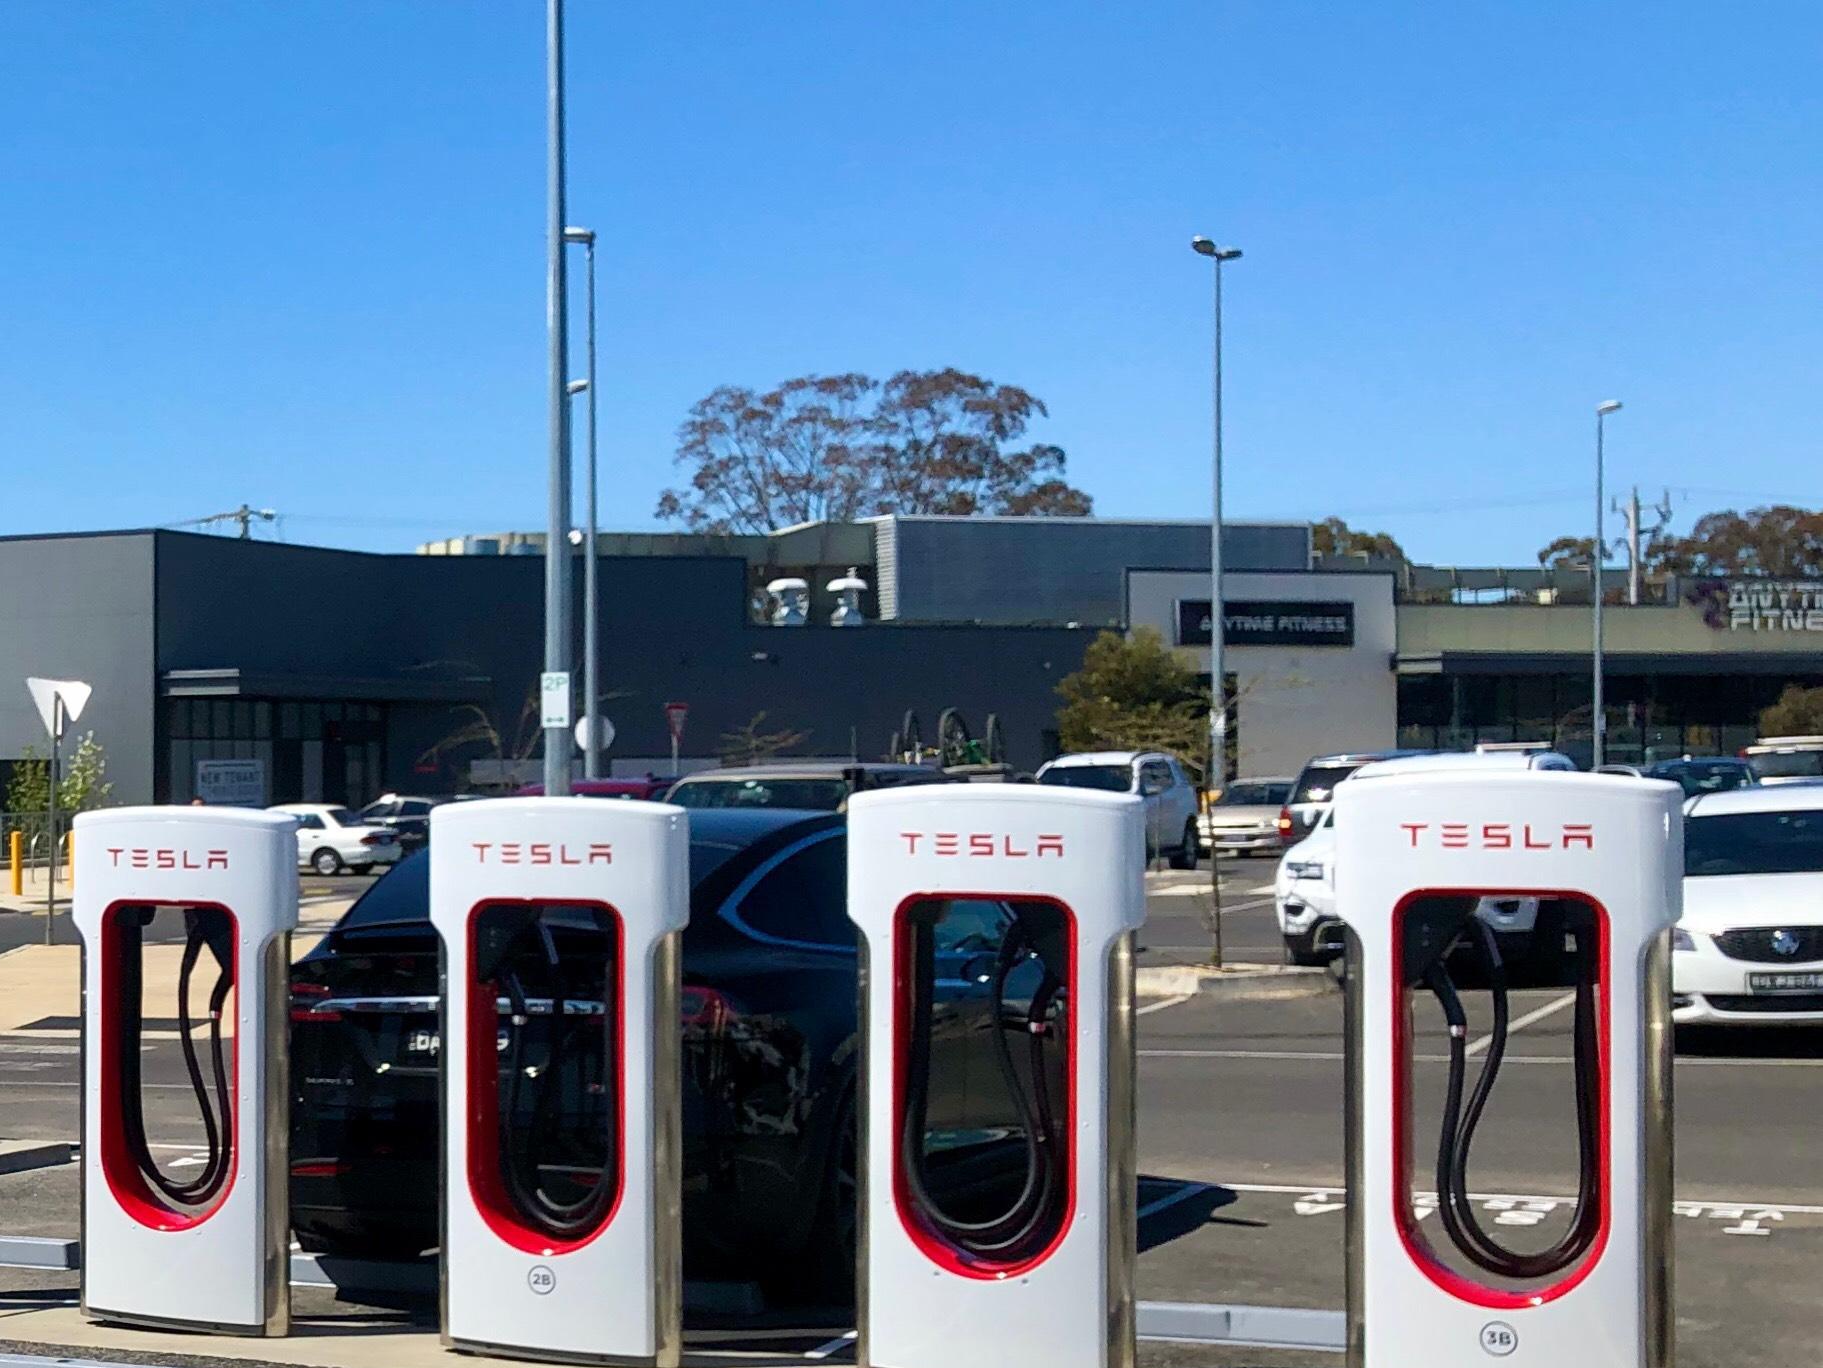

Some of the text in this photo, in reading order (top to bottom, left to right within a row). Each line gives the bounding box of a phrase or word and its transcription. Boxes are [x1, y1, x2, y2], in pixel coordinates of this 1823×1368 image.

[1278, 615, 1347, 633] FITNESS
[901, 832, 1064, 858] TESLA
[1401, 822, 1594, 850] TESLA
[107, 847, 229, 870] TESLA
[472, 842, 612, 866] TESLA
[533, 1273, 551, 1286] 2B
[1487, 1330, 1512, 1346] 3B
